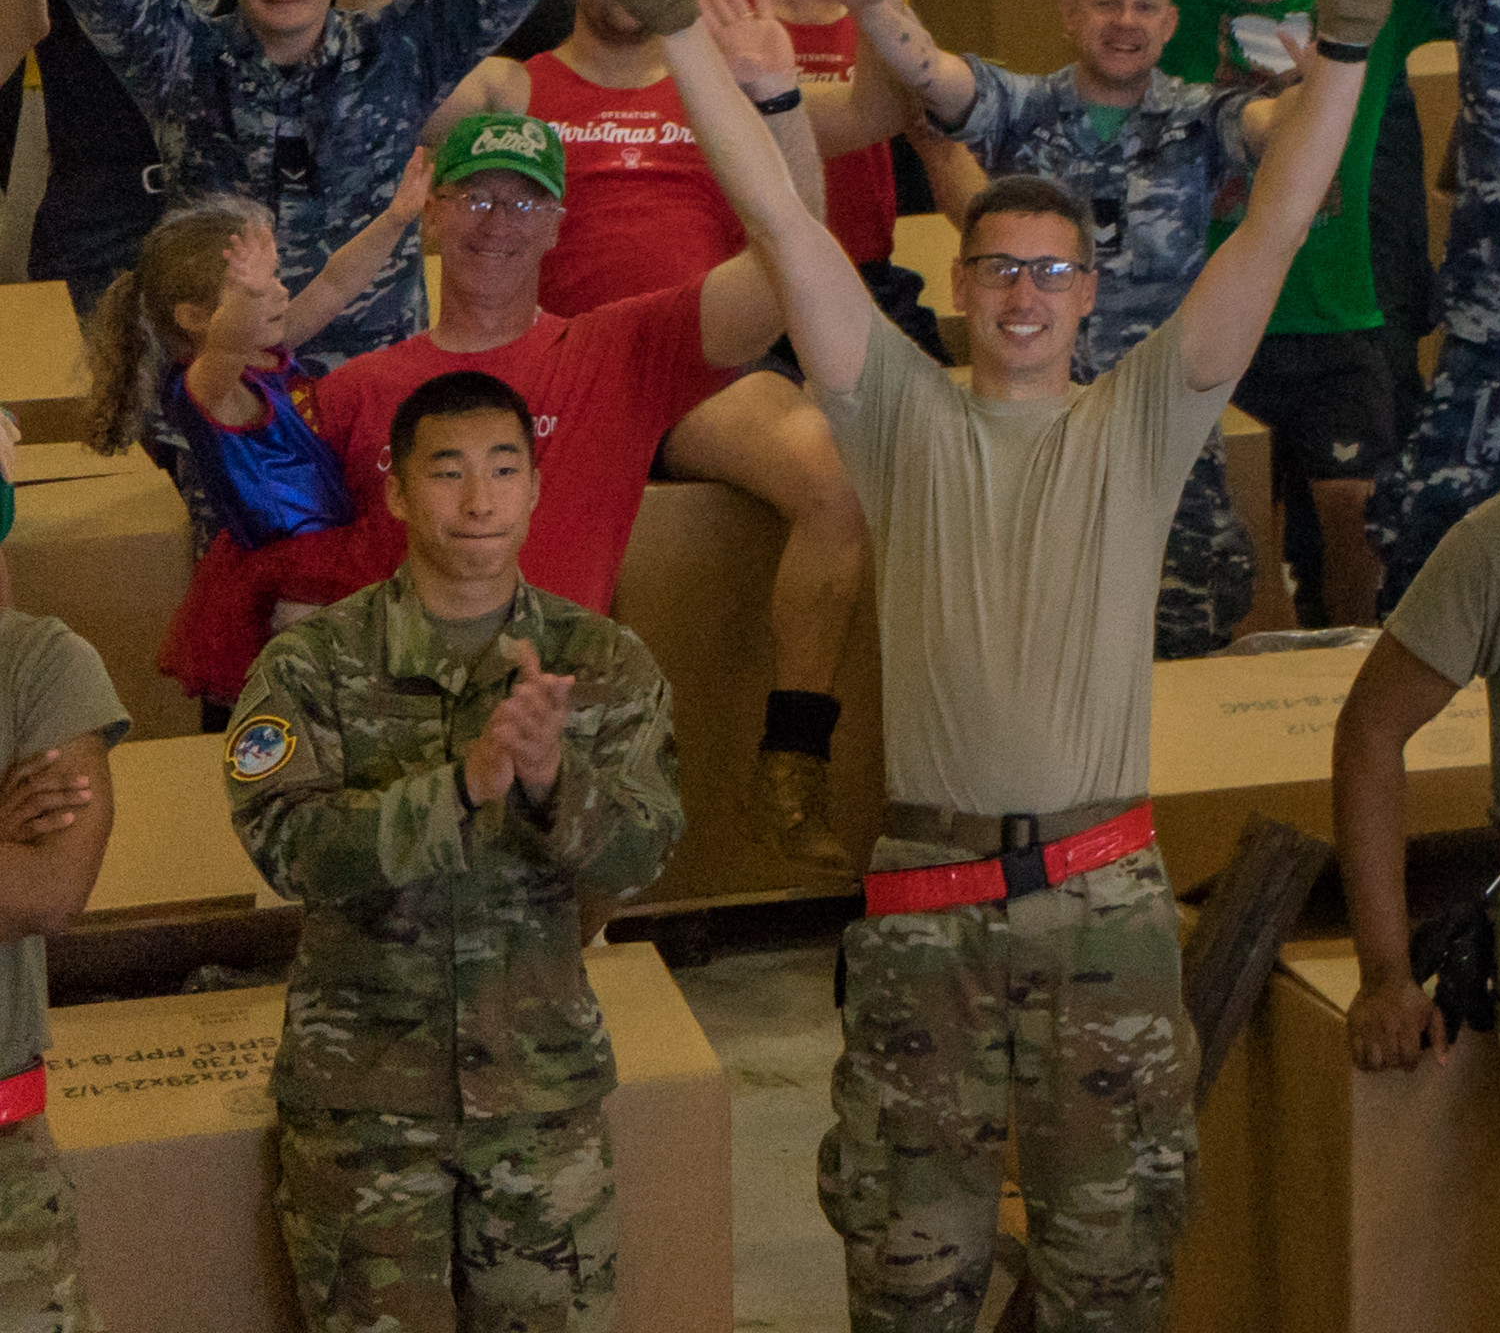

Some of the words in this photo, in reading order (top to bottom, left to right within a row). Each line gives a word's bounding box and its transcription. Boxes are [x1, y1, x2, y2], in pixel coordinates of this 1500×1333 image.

[601, 111, 657, 119] OPERATION
[658, 122, 696, 145] Dr
[194, 1035, 279, 1056] SPEC
[46, 1046, 186, 1071] PPP-B-13
[192, 1051, 275, 1070] 13730
[62, 1069, 248, 1100] 42x29x25-1/2
